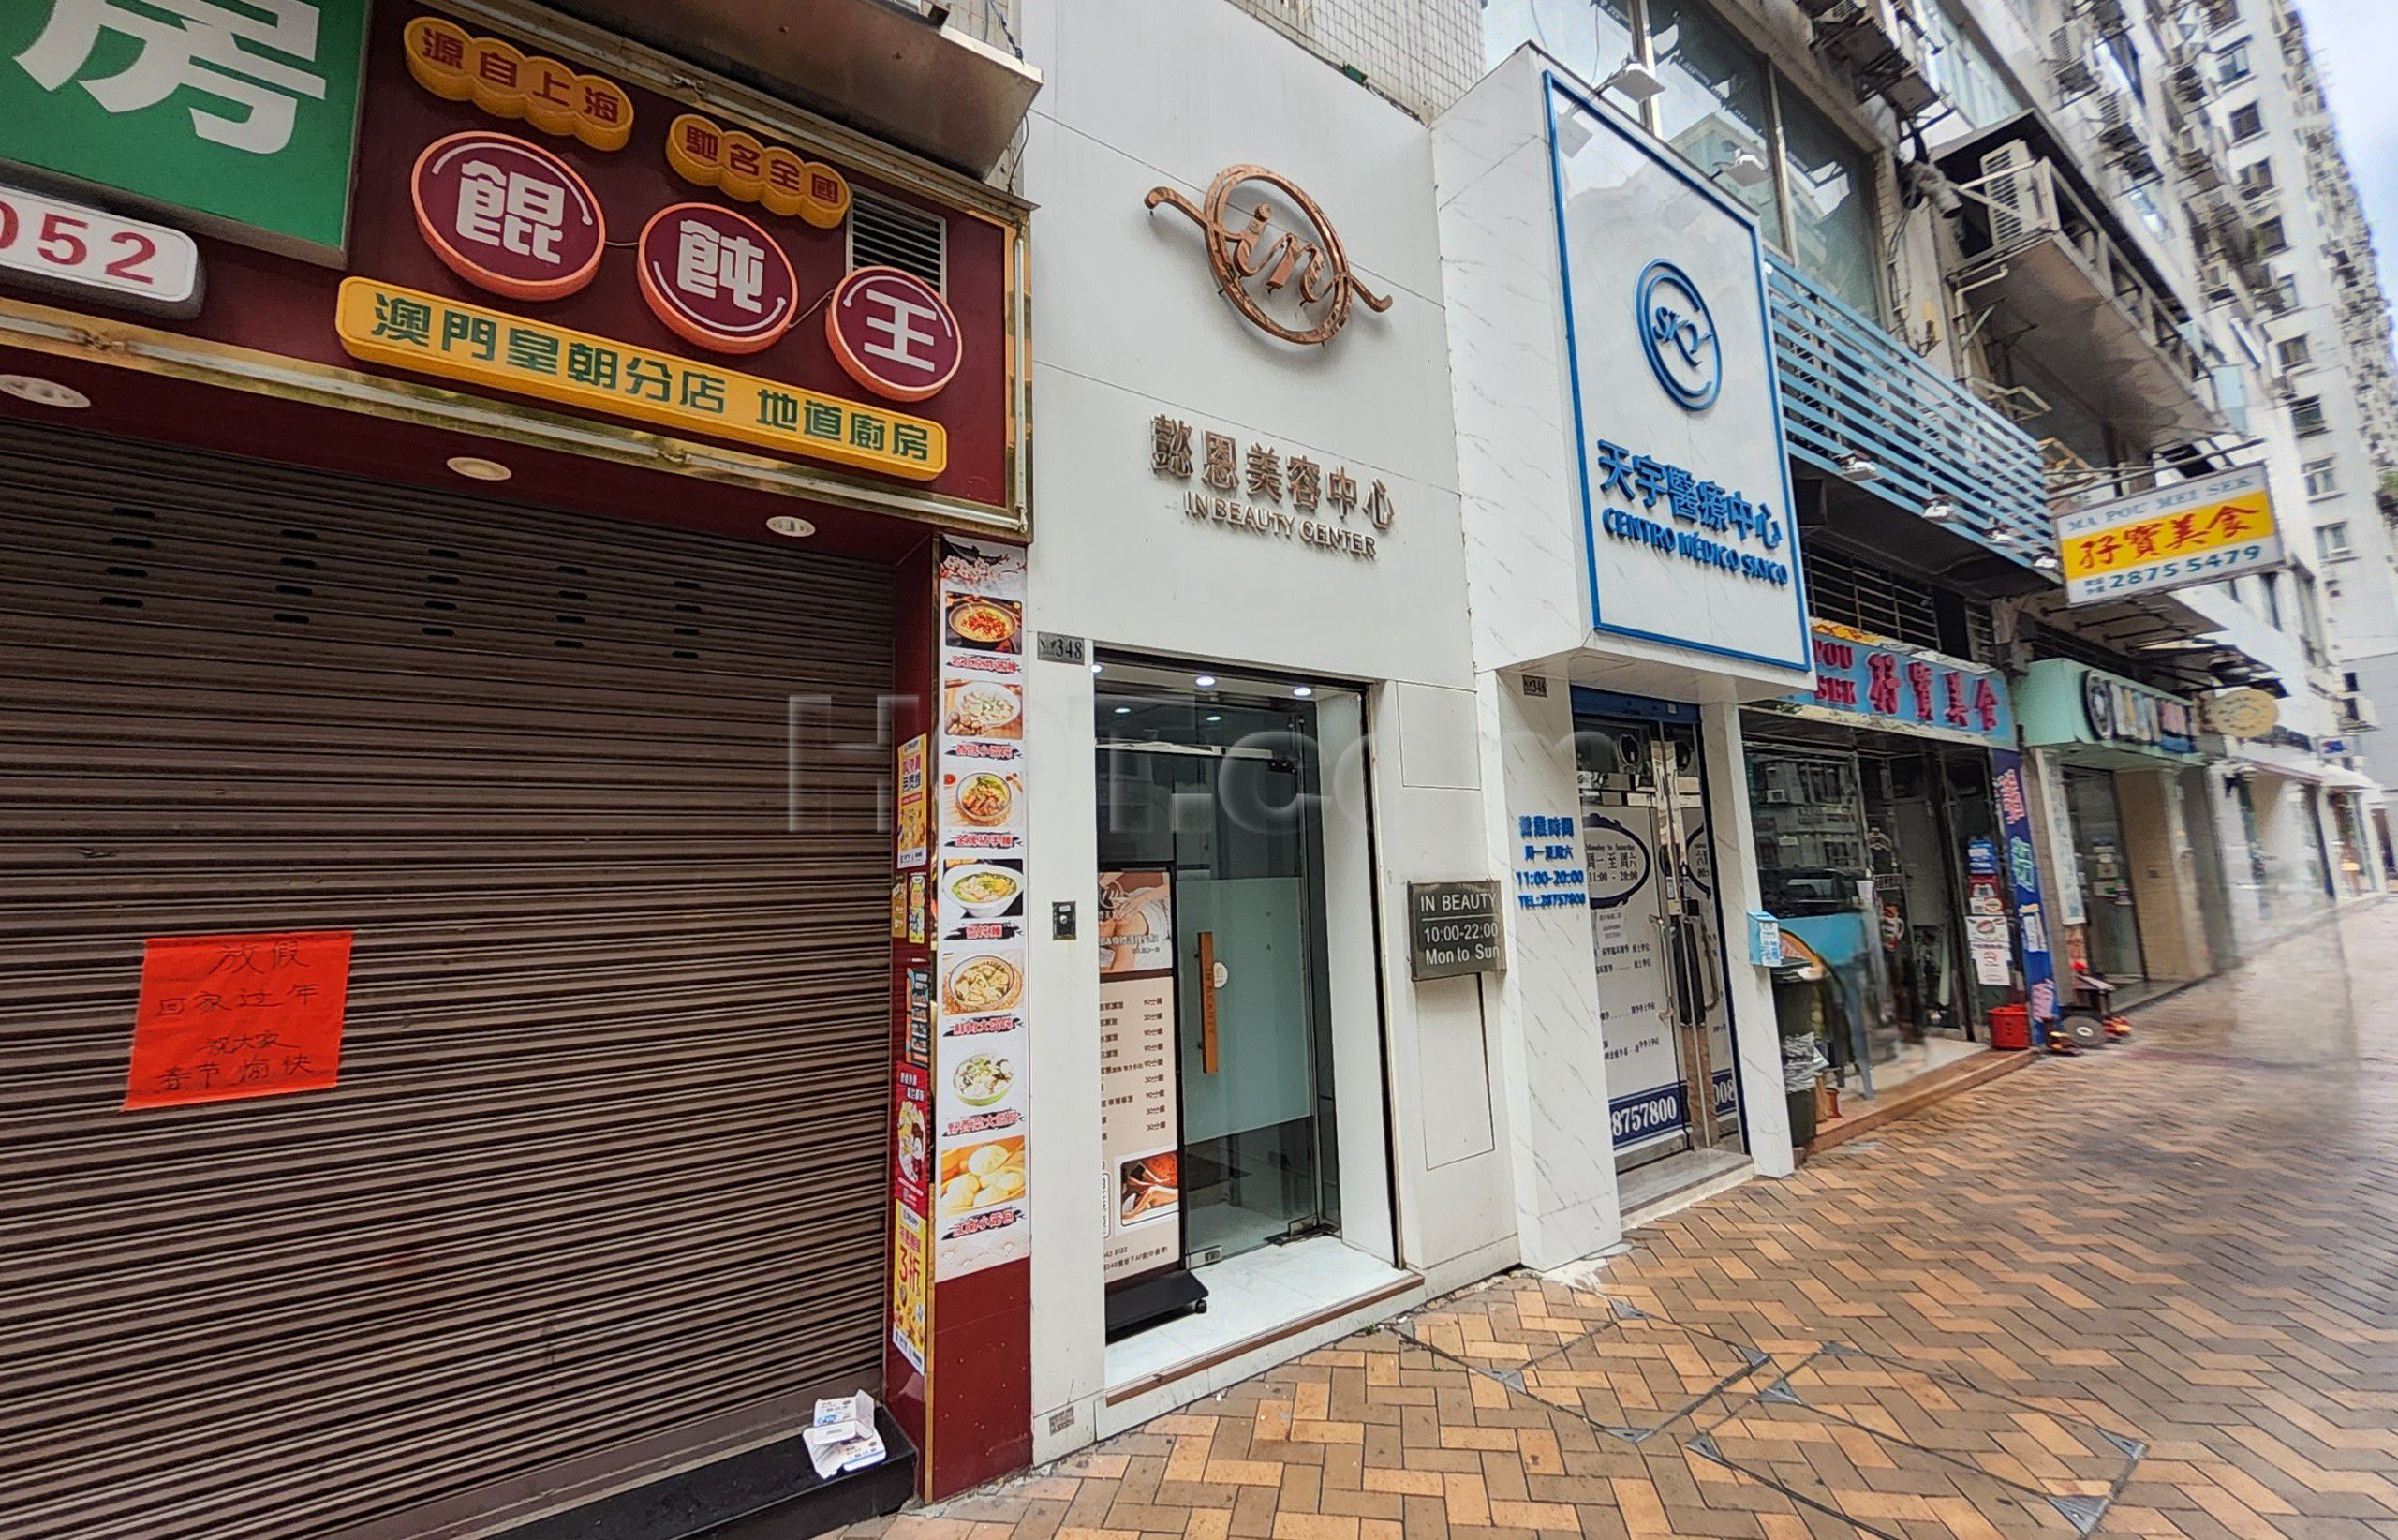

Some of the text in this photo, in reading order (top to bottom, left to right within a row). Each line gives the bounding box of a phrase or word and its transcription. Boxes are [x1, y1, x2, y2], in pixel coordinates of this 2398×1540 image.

[422, 27, 619, 124] 源自上海
[685, 123, 839, 204] 馳名全國
[371, 291, 929, 462] 澳門皇朝分店 地道廚房
[1150, 413, 1396, 530] 懿恩美容中心
[1597, 438, 1784, 550] 天宇醫療中心
[1184, 491, 1377, 557] IN BEAUTY CENTER
[1602, 507, 1676, 554] CENTRO
[1677, 531, 1740, 572] MÉDICO
[2109, 562, 2180, 589] 2875
[2186, 545, 2262, 572] 5479
[1518, 816, 1574, 837] 營業時間
[1420, 893, 1496, 912] IN BEAUTY
[1516, 870, 1584, 887] 11:00-20:00
[1424, 923, 1499, 943] 10:00-22:00
[1426, 944, 1500, 966] Mon to Sun
[1611, 1090, 1677, 1137] 8757800
